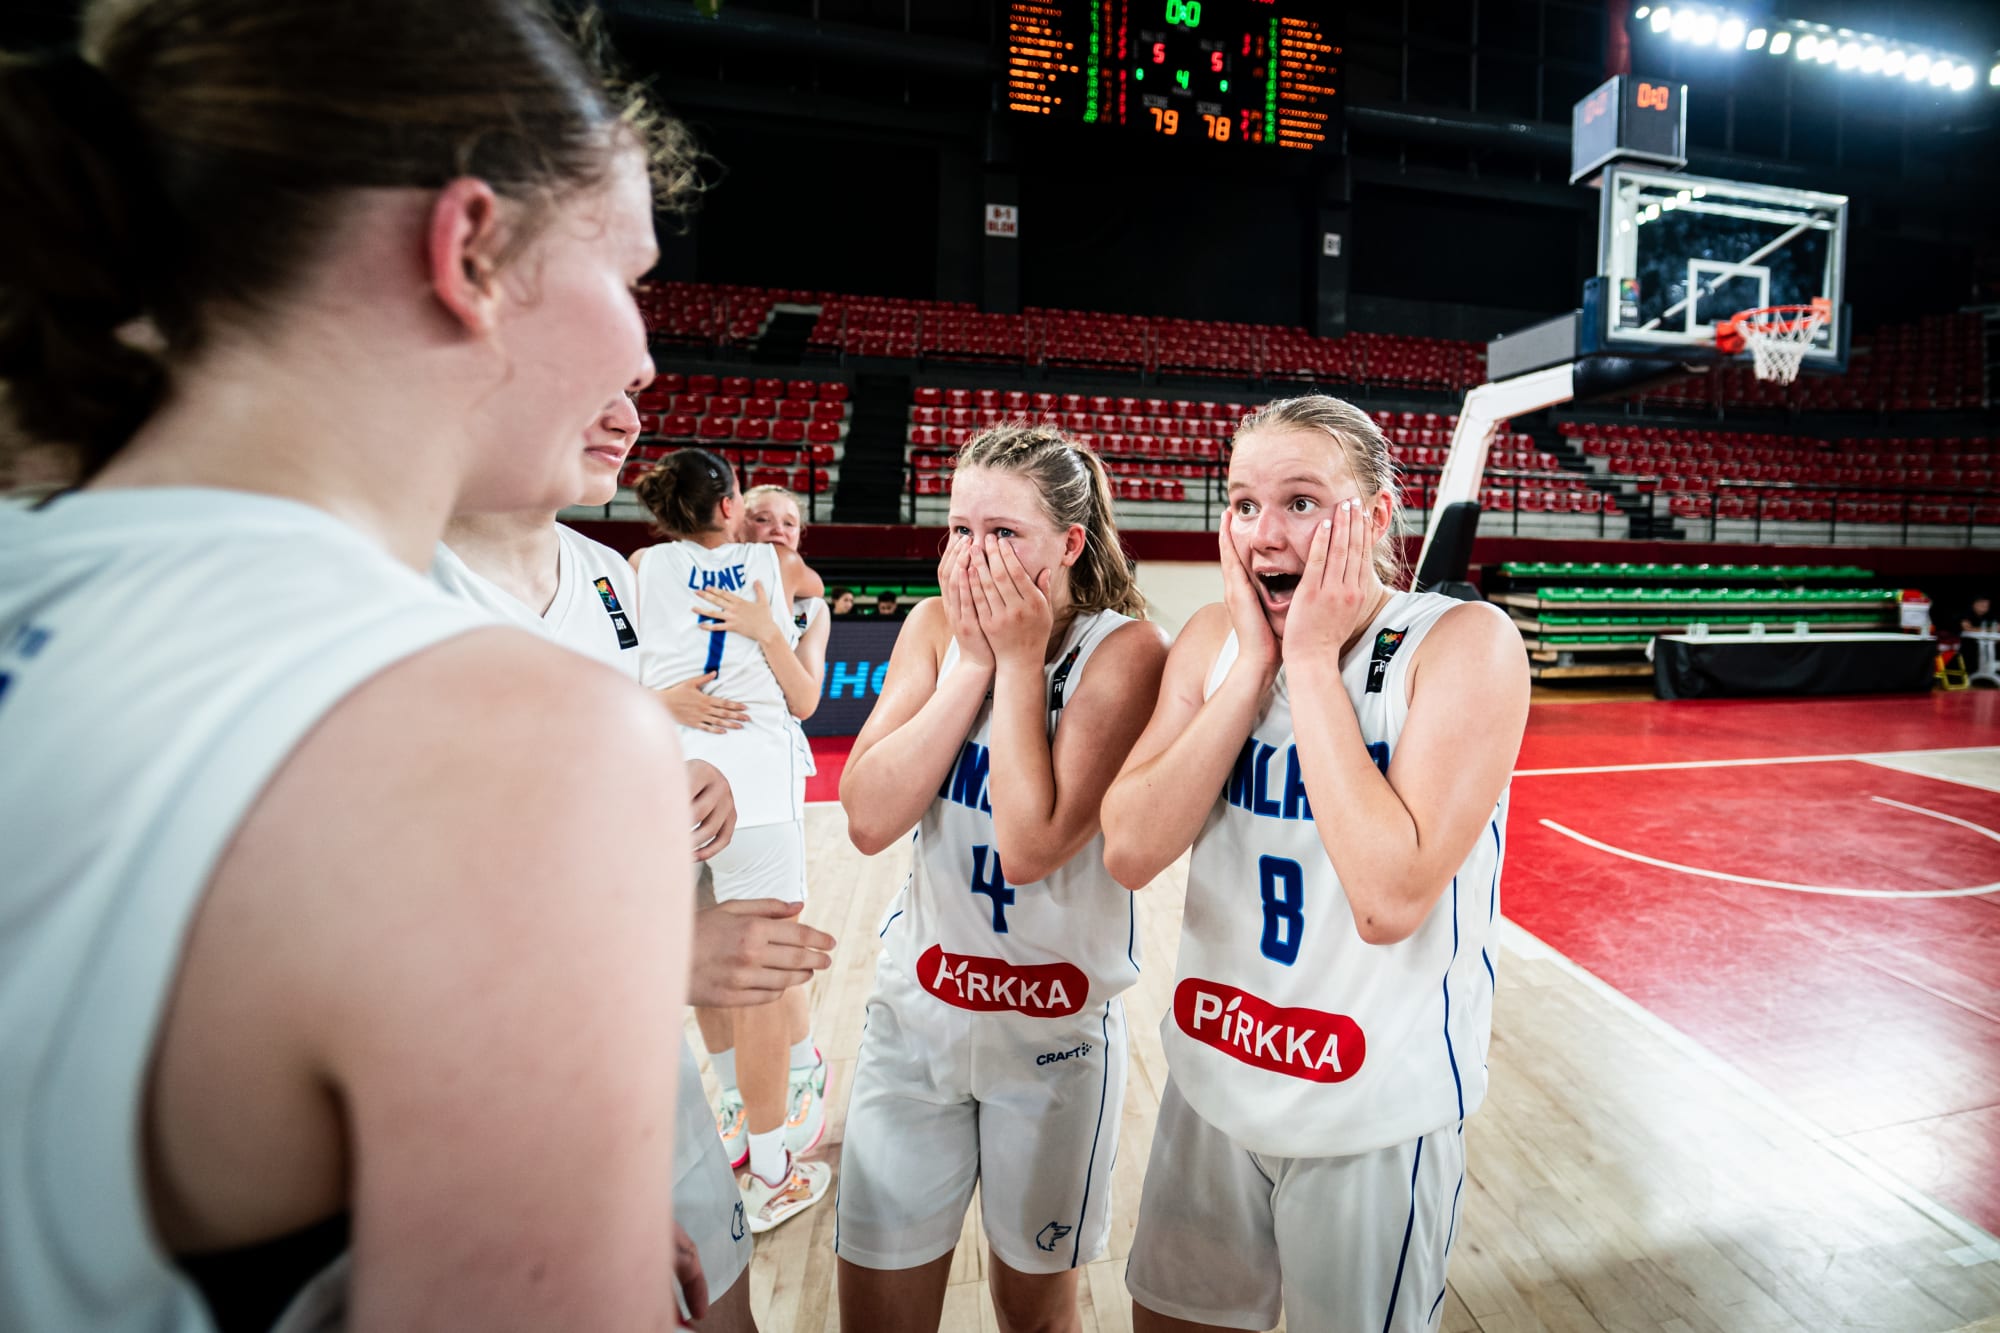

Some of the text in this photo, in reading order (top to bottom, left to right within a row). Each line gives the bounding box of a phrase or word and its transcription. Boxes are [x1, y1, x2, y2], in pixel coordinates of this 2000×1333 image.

[1153, 42, 1166, 64] 5
[1211, 51, 1223, 72] 5
[1176, 69, 1190, 90] 4
[1149, 107, 1179, 135] 79
[1202, 113, 1231, 142] 78
[970, 844, 1016, 934] 4
[1258, 854, 1305, 967] 8
[1036, 1047, 1081, 1066] CRAFT
